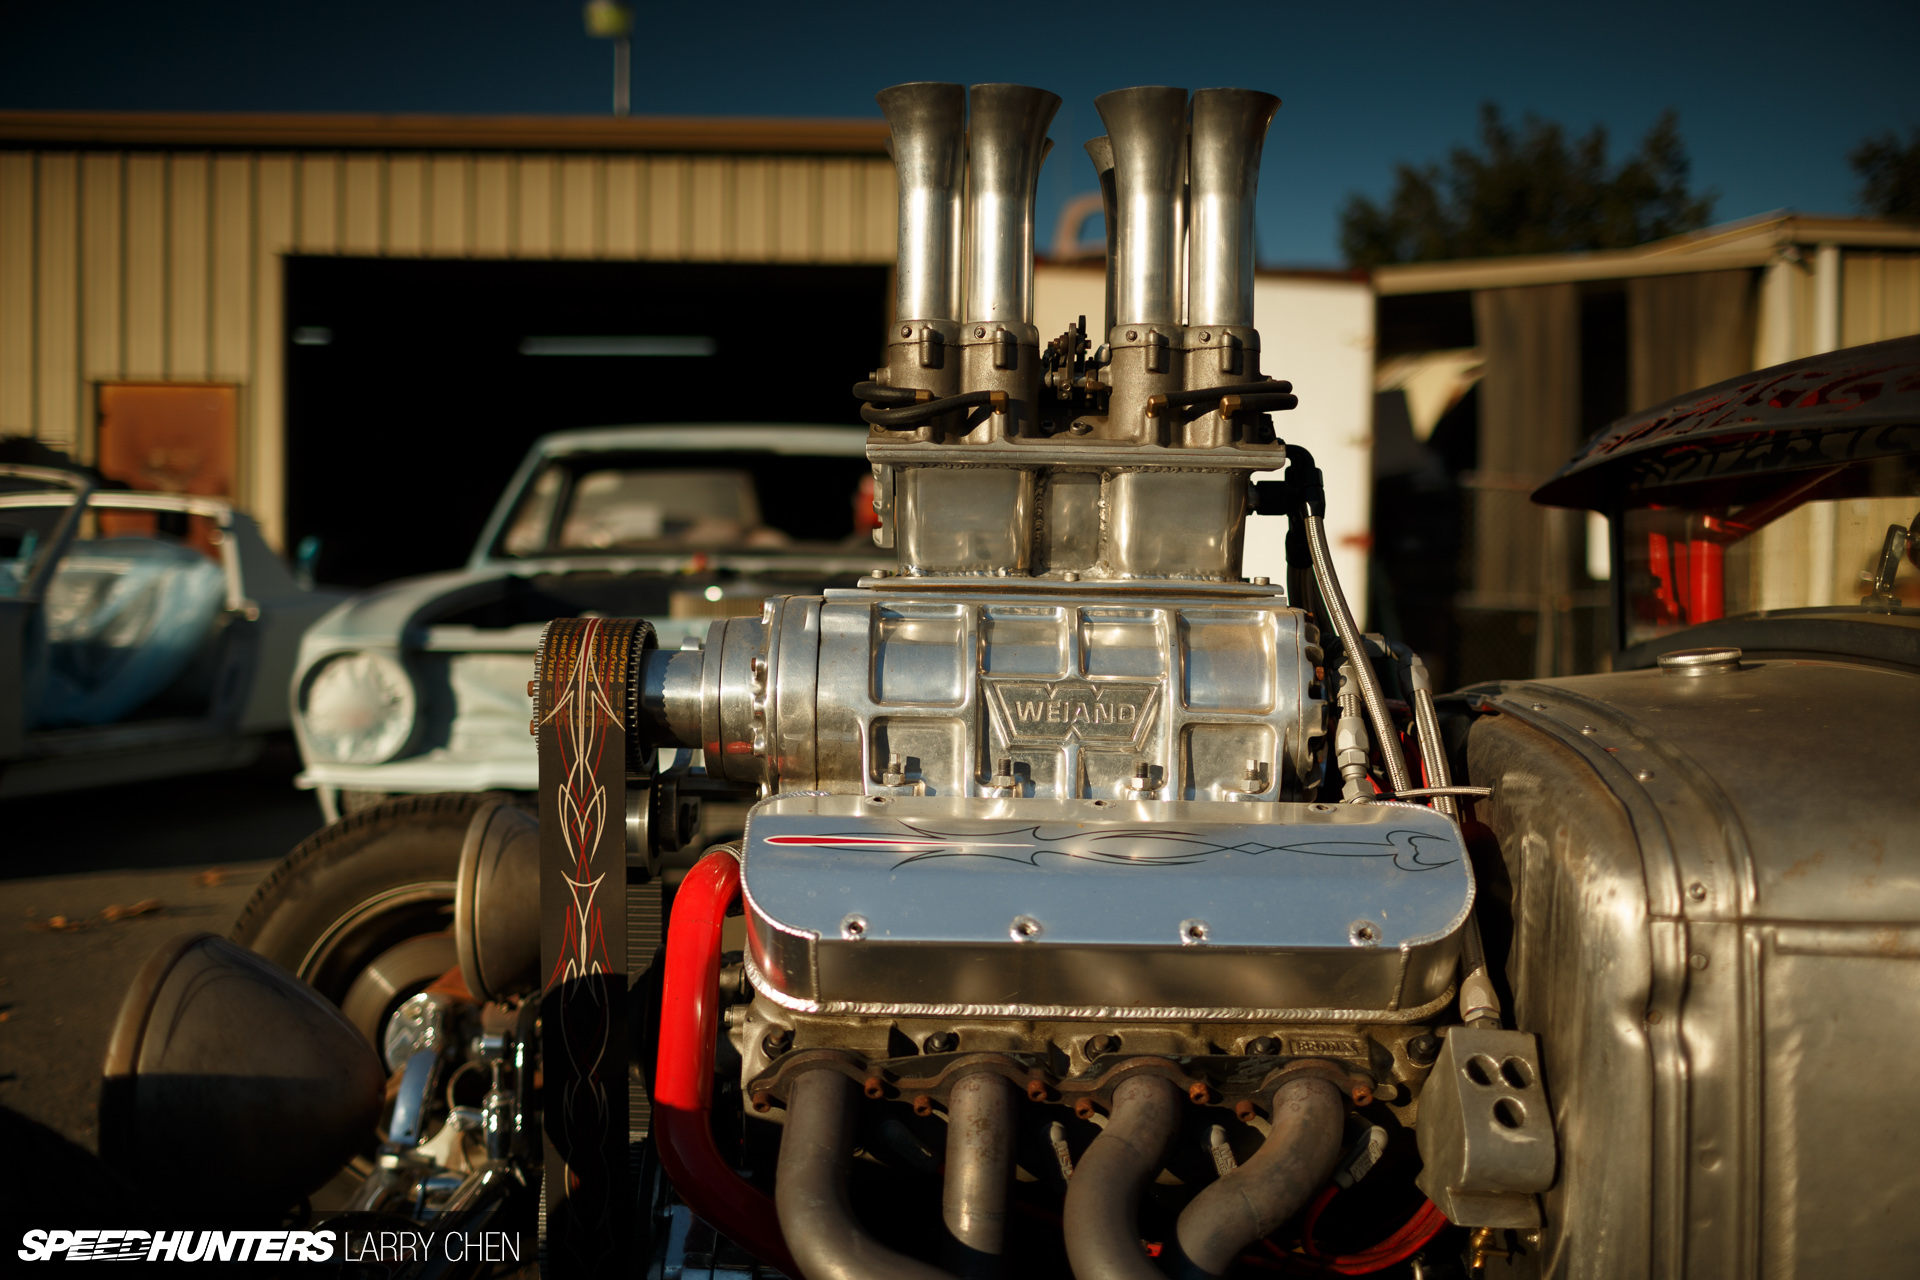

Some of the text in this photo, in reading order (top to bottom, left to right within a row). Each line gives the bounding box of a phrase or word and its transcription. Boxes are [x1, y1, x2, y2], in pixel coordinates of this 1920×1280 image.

[547, 635, 559, 682] GOODYEAR
[618, 636, 630, 683] GOODYEAR
[1015, 700, 1136, 724] WEIAND
